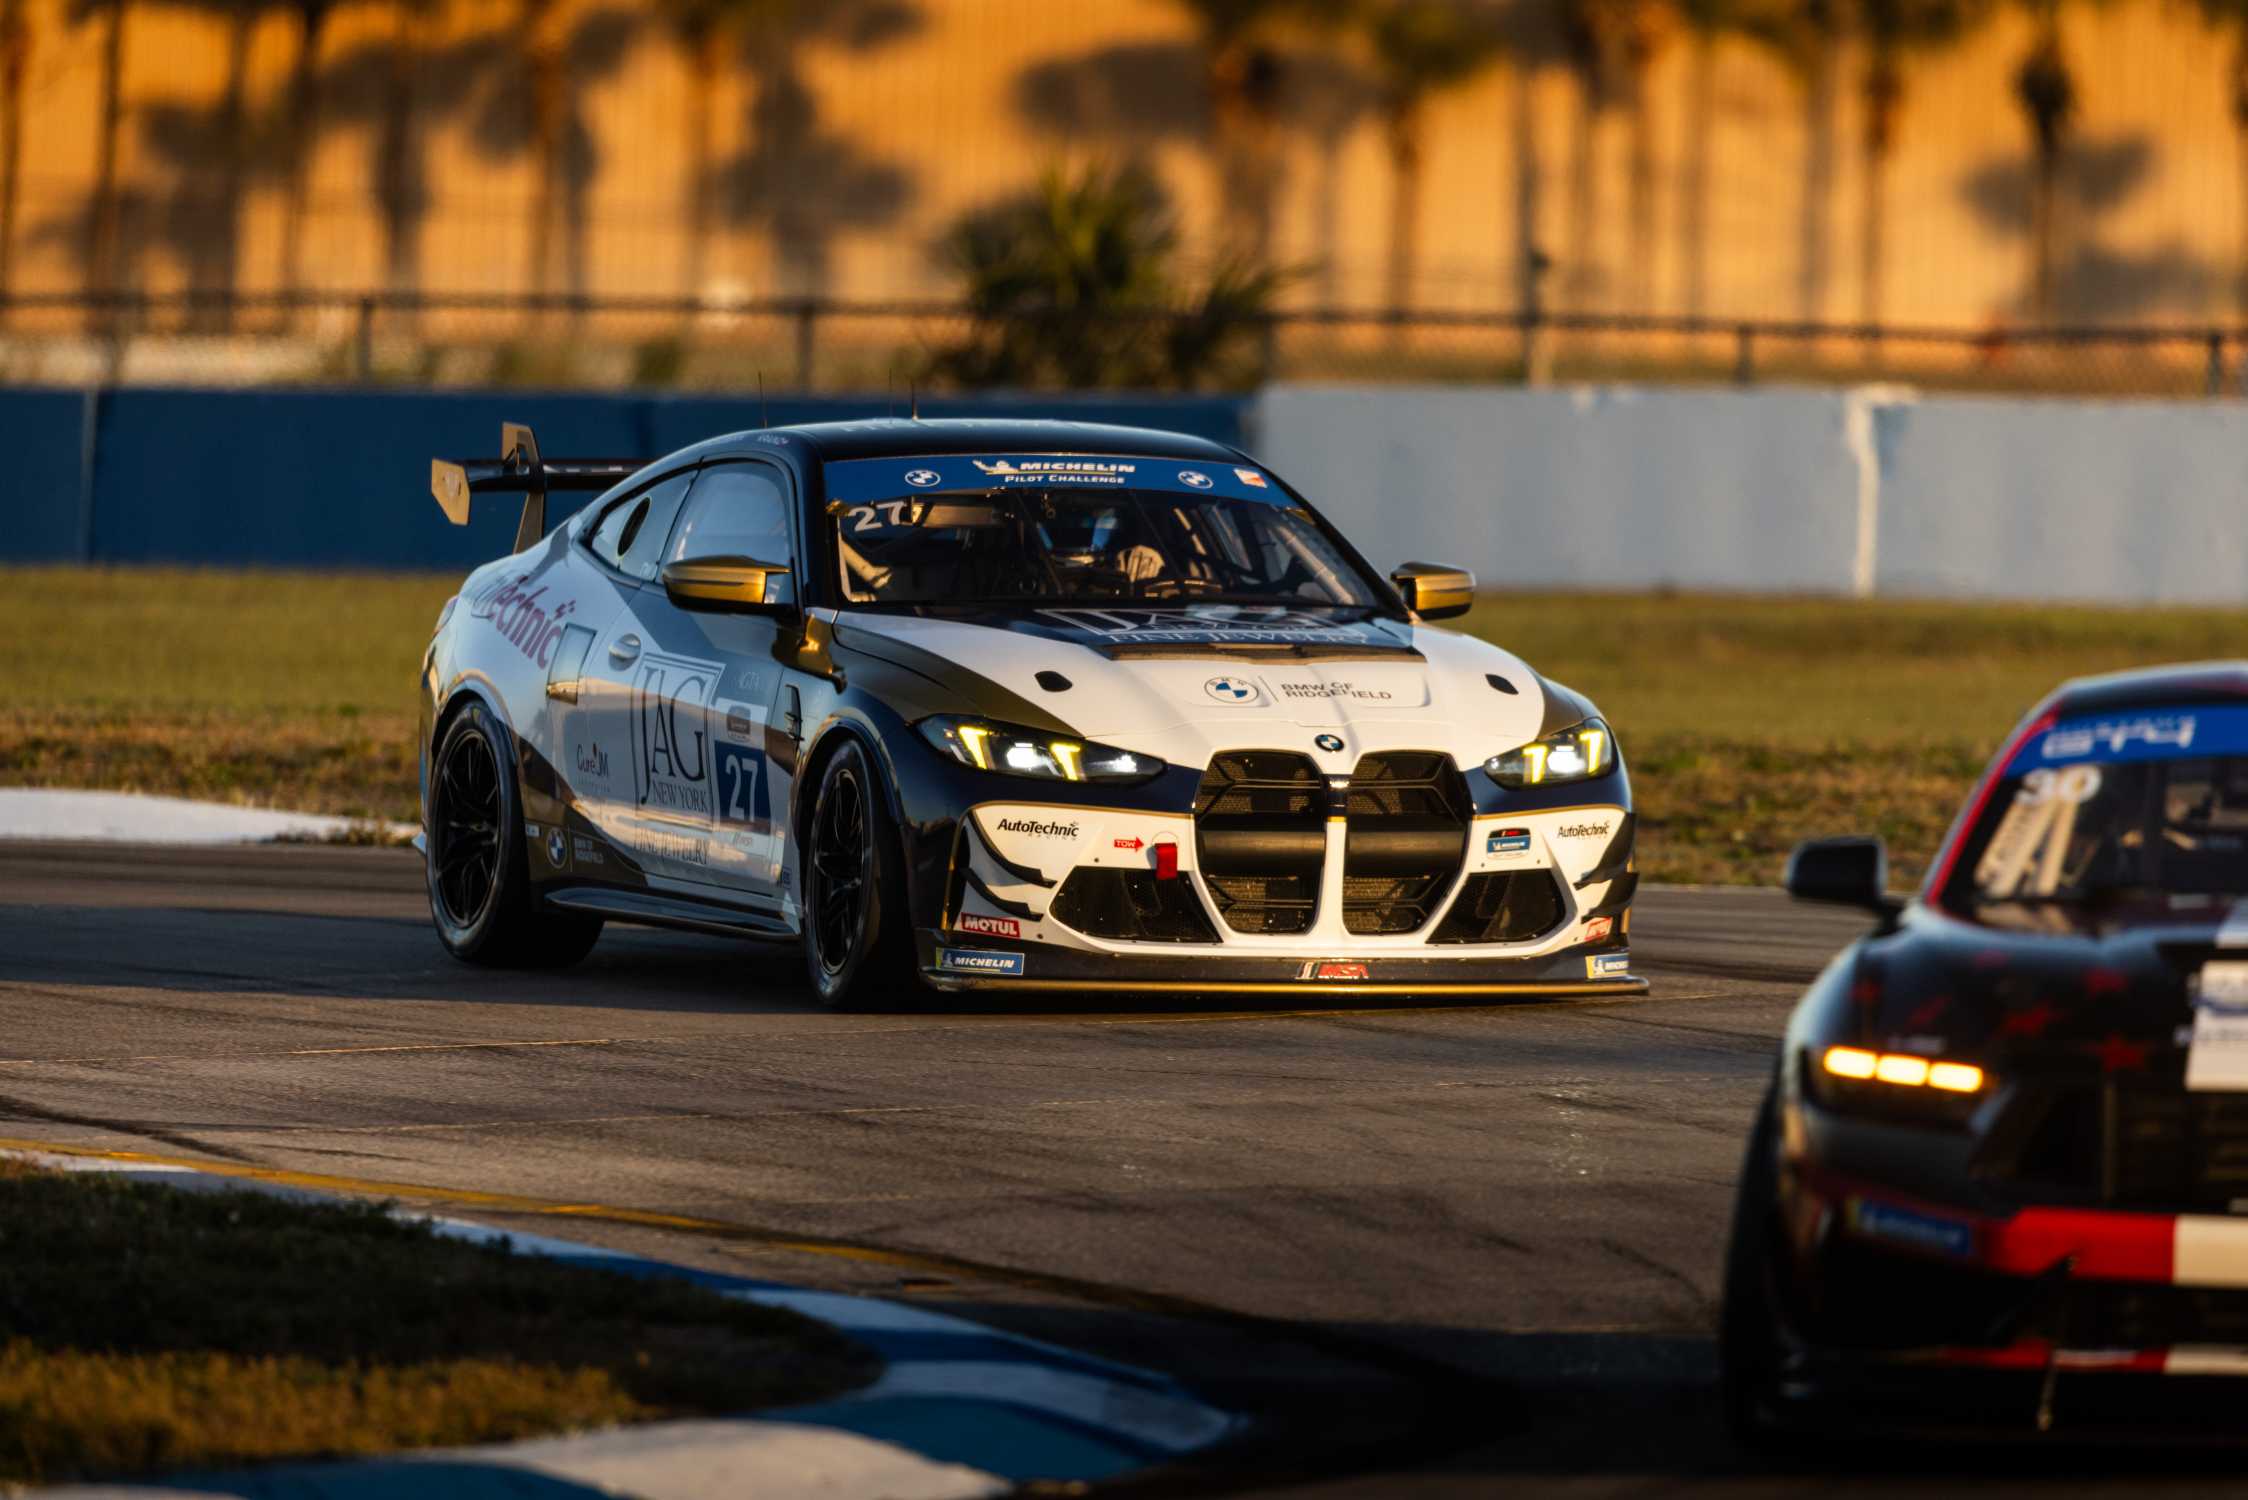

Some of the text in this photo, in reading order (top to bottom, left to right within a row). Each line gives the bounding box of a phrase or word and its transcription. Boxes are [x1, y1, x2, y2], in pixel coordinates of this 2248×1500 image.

[1020, 462, 1136, 473] MICHELIN
[1005, 474, 1125, 484] PILOT CHALLENGE
[848, 500, 908, 532] 27
[1109, 633, 1200, 643] FINE
[1281, 682, 1326, 692] BMW
[640, 665, 706, 805] JAG
[652, 780, 708, 813] NEW YORK
[725, 754, 758, 824] 27
[997, 818, 1079, 837] AutoTechnic
[1557, 822, 1610, 838] AutoTechnic
[1115, 839, 1137, 849] TOW
[964, 916, 1018, 935] MOTUL
[954, 957, 1015, 969] MICHELIN
